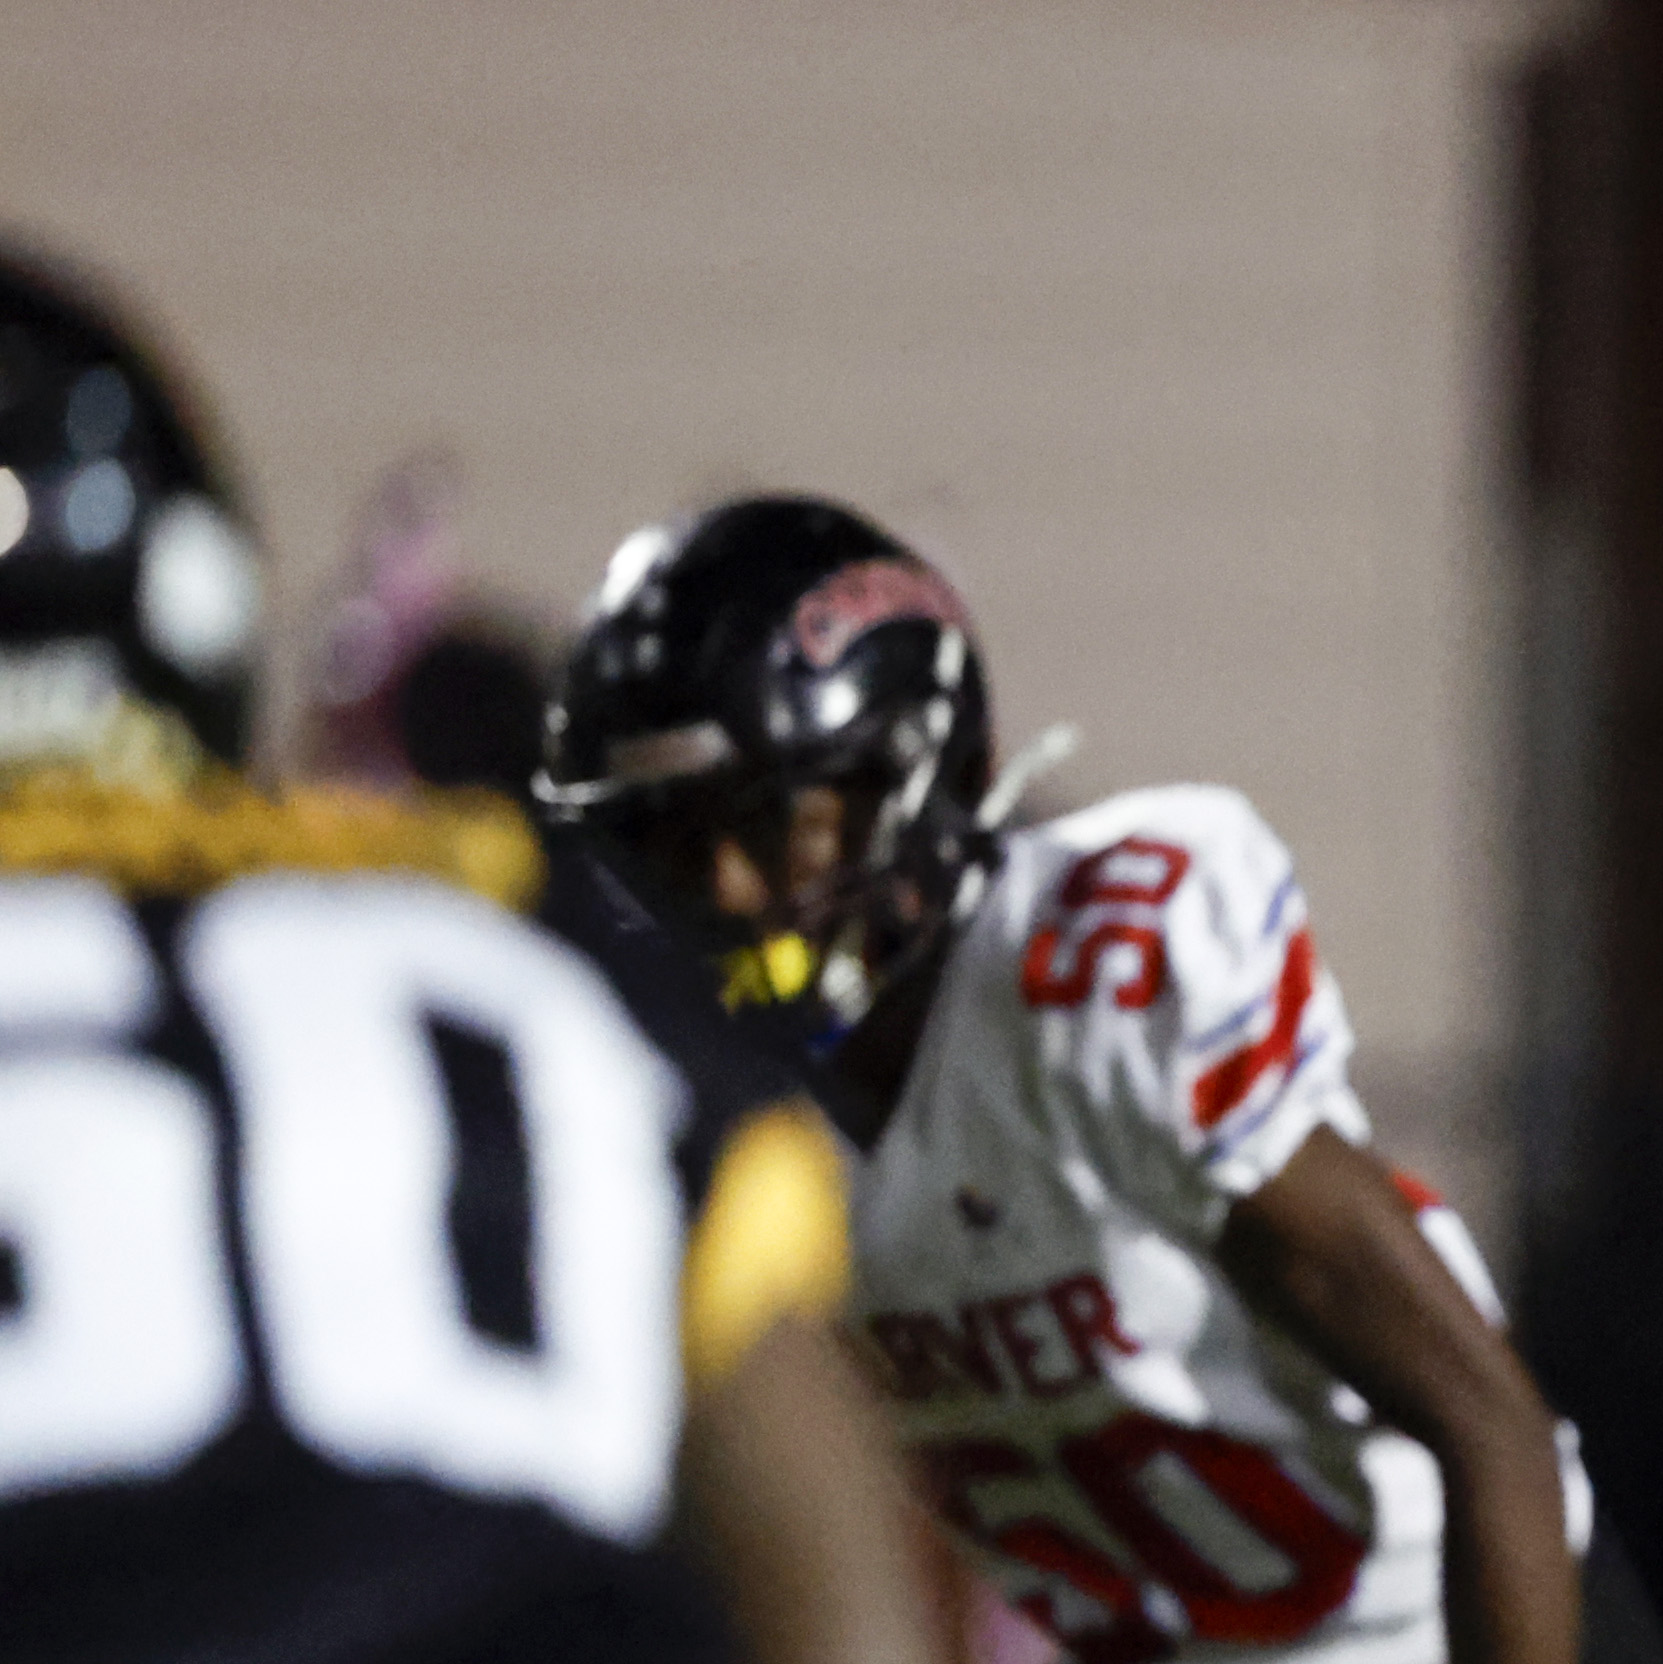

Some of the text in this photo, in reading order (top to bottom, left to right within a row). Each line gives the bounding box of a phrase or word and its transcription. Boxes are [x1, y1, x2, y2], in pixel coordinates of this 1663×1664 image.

[1018, 833, 1190, 1011] 50
[838, 1273, 1142, 1402] RVER
[910, 1412, 1369, 1662] 50
